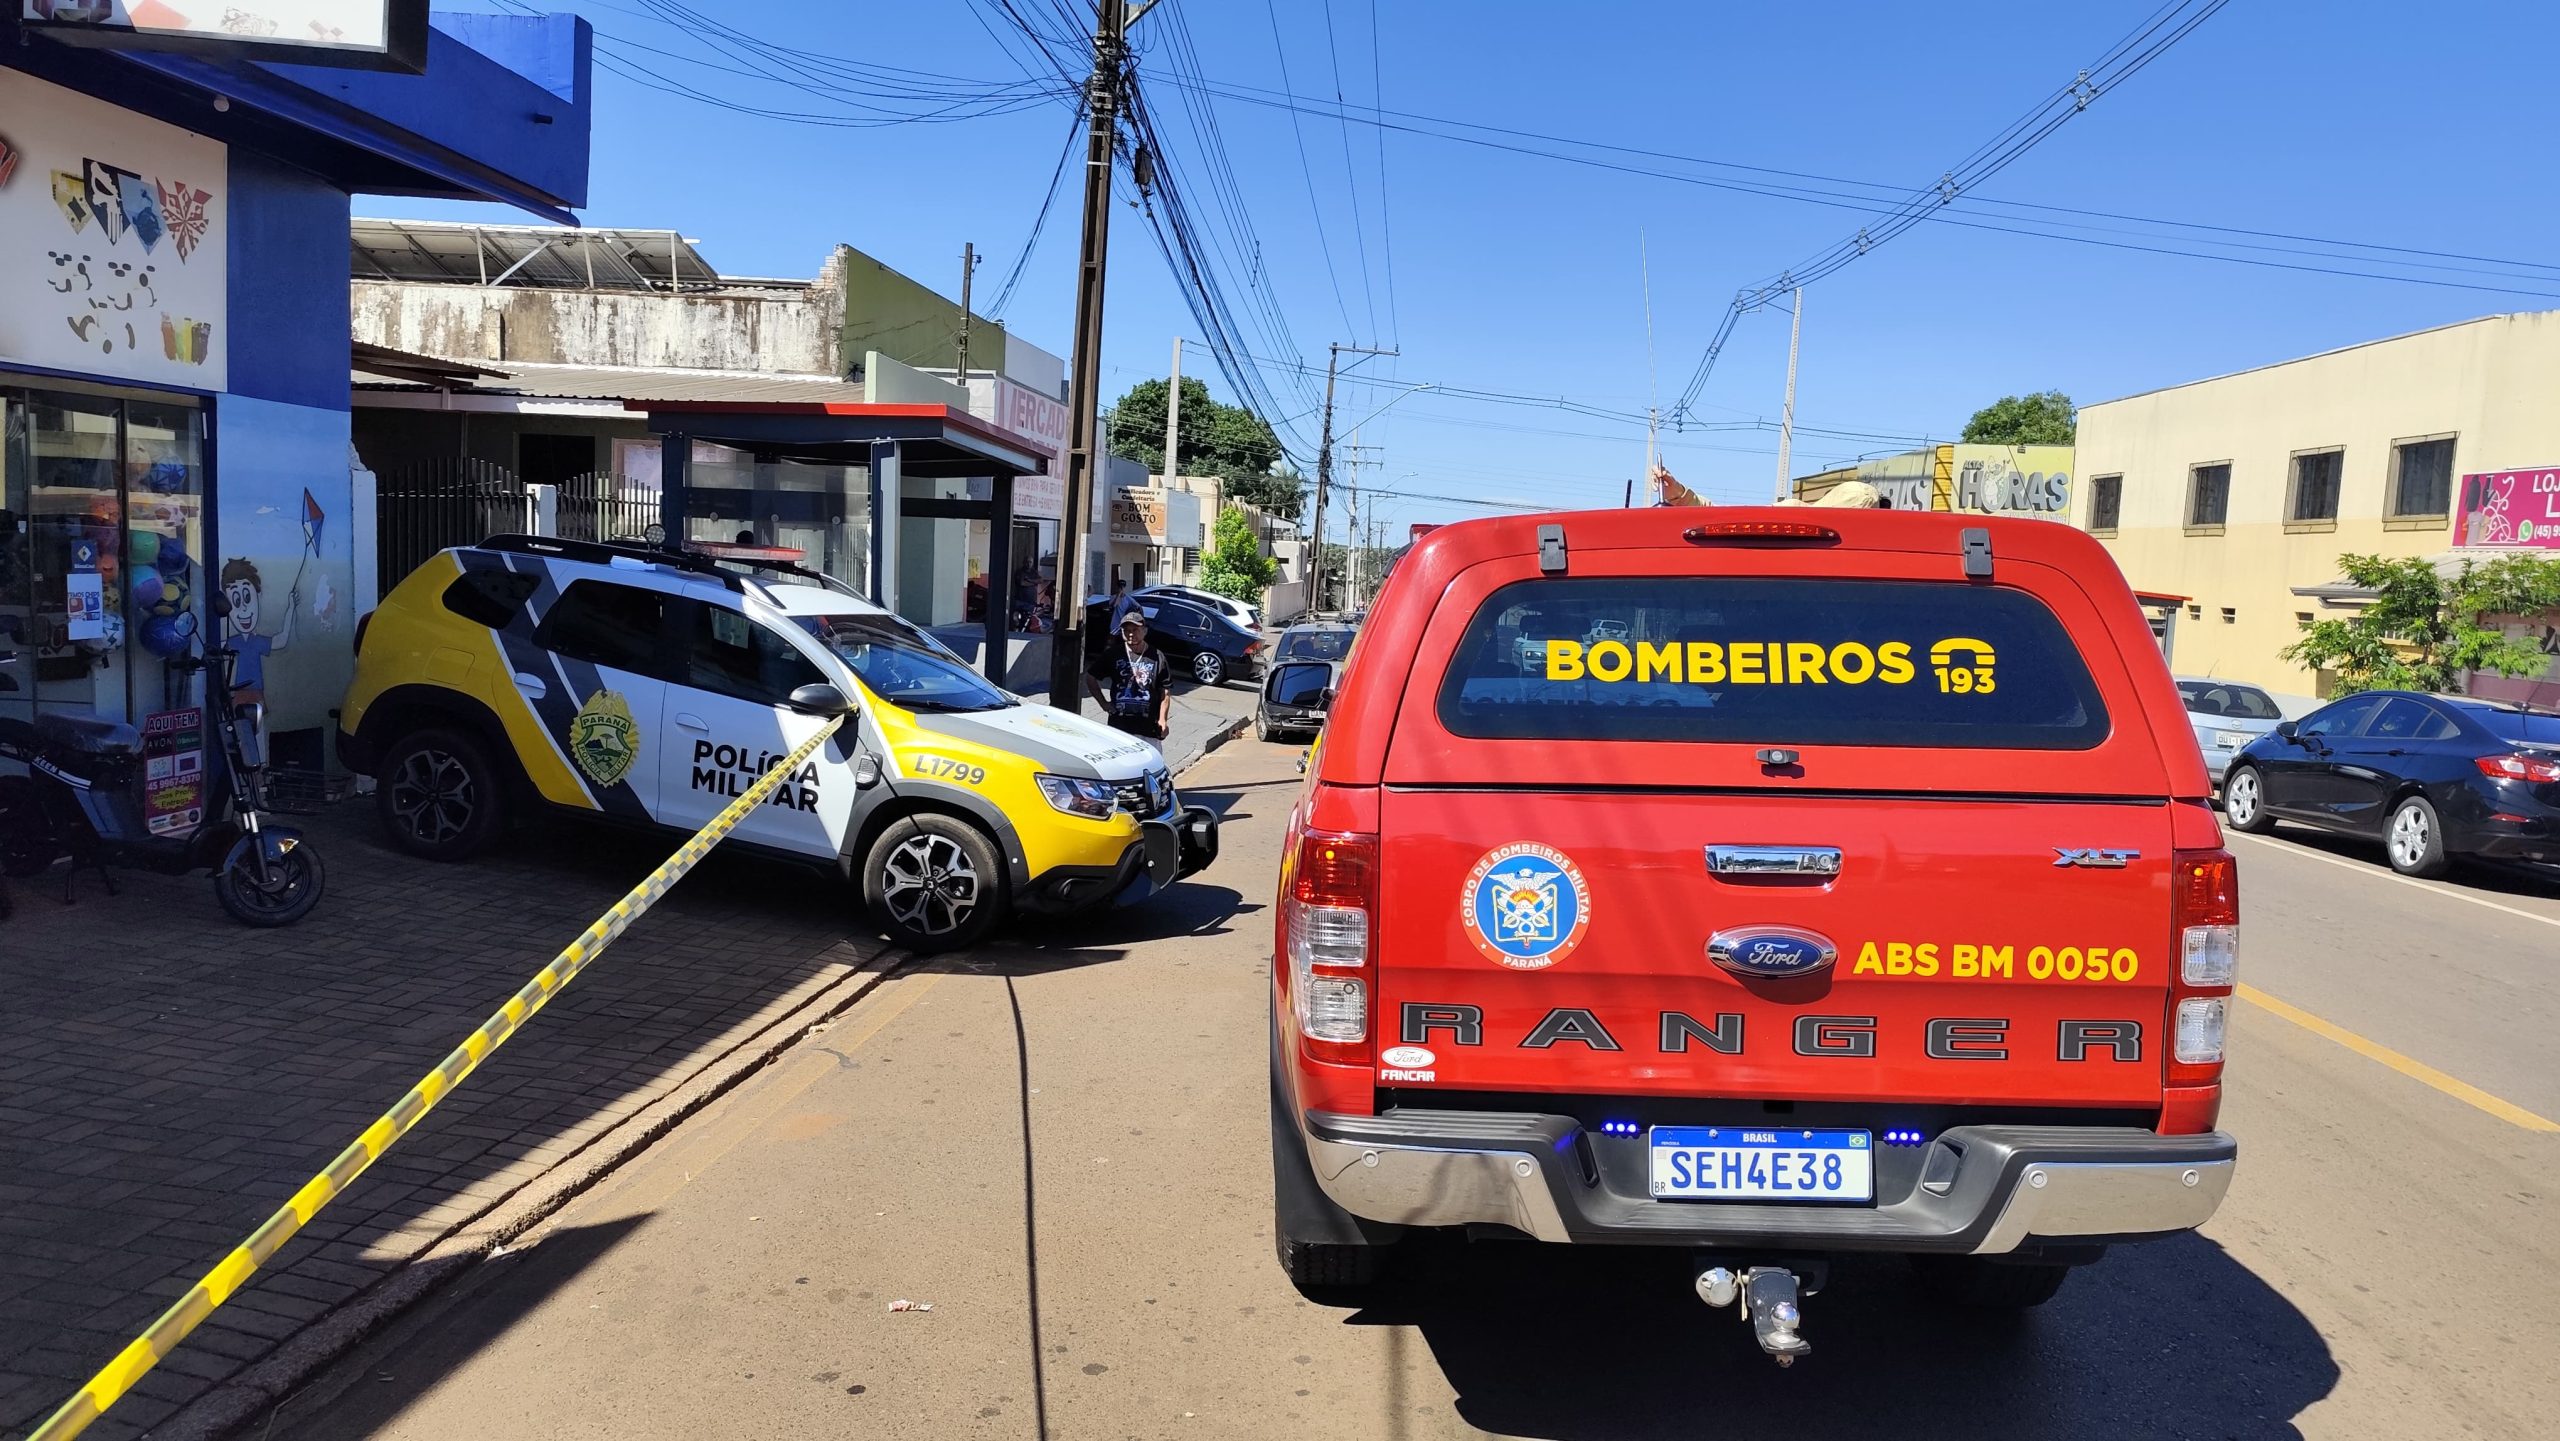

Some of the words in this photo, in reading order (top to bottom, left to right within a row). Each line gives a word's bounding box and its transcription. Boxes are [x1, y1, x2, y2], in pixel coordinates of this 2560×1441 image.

[1963, 460, 1984, 471] ALTAS
[1958, 471, 2069, 514] HORAS
[1128, 502, 1151, 513] BOM
[1121, 513, 1156, 523] GOSTO
[2534, 524, 2552, 539] (45)
[1546, 639, 1915, 684] BOMBEIROS
[1934, 667, 1996, 694] 193
[148, 715, 173, 733] AQUI
[583, 716, 628, 730] PARANÁ
[148, 737, 172, 748] AVON
[607, 751, 629, 777] MILITAR
[914, 755, 985, 785] L1799
[147, 781, 158, 791] 45
[692, 766, 818, 814] MILIAR
[2052, 847, 2140, 869] XLT
[1463, 879, 1477, 927] CORPO
[1474, 859, 1490, 876] DE
[1491, 843, 1570, 869] BOMBEIROS
[1569, 869, 1590, 924] MILITAR
[1503, 955, 1552, 968] PARANÁ
[1748, 942, 1803, 965] Ford
[1852, 941, 1940, 977] ABS
[1952, 943, 2014, 979] BM
[2027, 946, 2139, 982] 0050
[1400, 1001, 2142, 1063] RANGER
[1393, 1049, 1424, 1063] Ford
[1381, 1069, 1435, 1082] FANCAR
[1743, 1133, 1777, 1143] BRASIL
[1671, 1151, 1842, 1191] SEH4E38
[1655, 1181, 1666, 1193] BR
